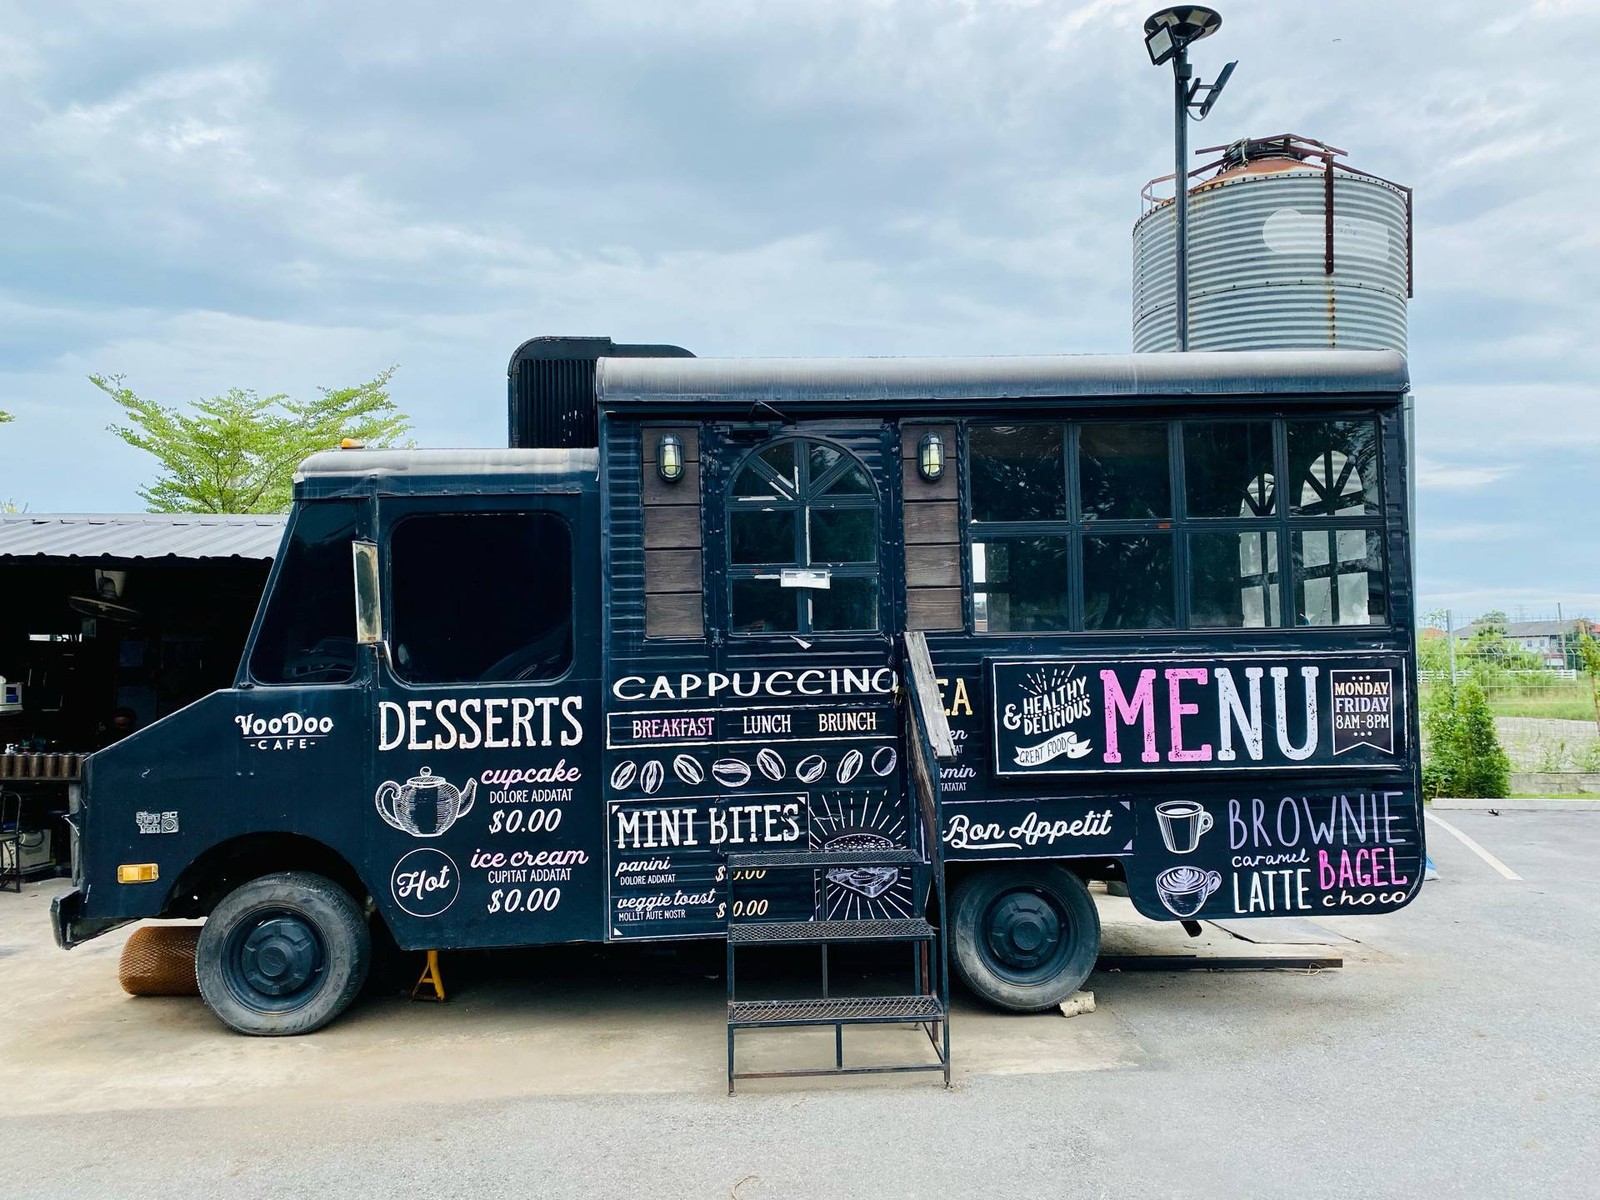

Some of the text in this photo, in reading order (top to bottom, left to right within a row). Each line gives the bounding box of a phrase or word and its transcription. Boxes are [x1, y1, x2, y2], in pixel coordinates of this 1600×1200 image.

[612, 667, 898, 700] CAPPUCCINO
[1024, 676, 1087, 715] HEALTHY
[1334, 682, 1389, 696] MONDAY
[1003, 698, 1092, 736] & DELICIOUS
[1100, 667, 1319, 763] MENU
[1335, 697, 1390, 713] FRIDAY
[378, 695, 583, 751] DESSERTS
[632, 711, 877, 739] BREAKFAST LUNCH BRUNCH
[1335, 714, 1390, 730] 8AM-8PM
[1046, 736, 1067, 758] FOOD
[480, 758, 582, 790] cupcake
[489, 788, 573, 804] DOLORE ADDATAT
[488, 808, 562, 834] $0.00
[617, 803, 801, 850] MINI BITES
[942, 809, 1113, 850] Bon Appetit
[1228, 791, 1407, 851] BROWNIE
[470, 849, 589, 869] ice cream
[615, 856, 671, 877] panini
[1231, 847, 1408, 890] caramel BAGEL
[397, 865, 450, 900] Hot
[488, 868, 572, 884] CUPITAT ADDATAT
[620, 873, 676, 886] DOLORE ADDATAT
[487, 887, 561, 914] $0.00
[617, 888, 717, 912] veggie toast
[1233, 869, 1312, 914] LATTE
[1322, 890, 1407, 907] choco
[618, 909, 686, 922] MOLLIT AUTE NOSTR
